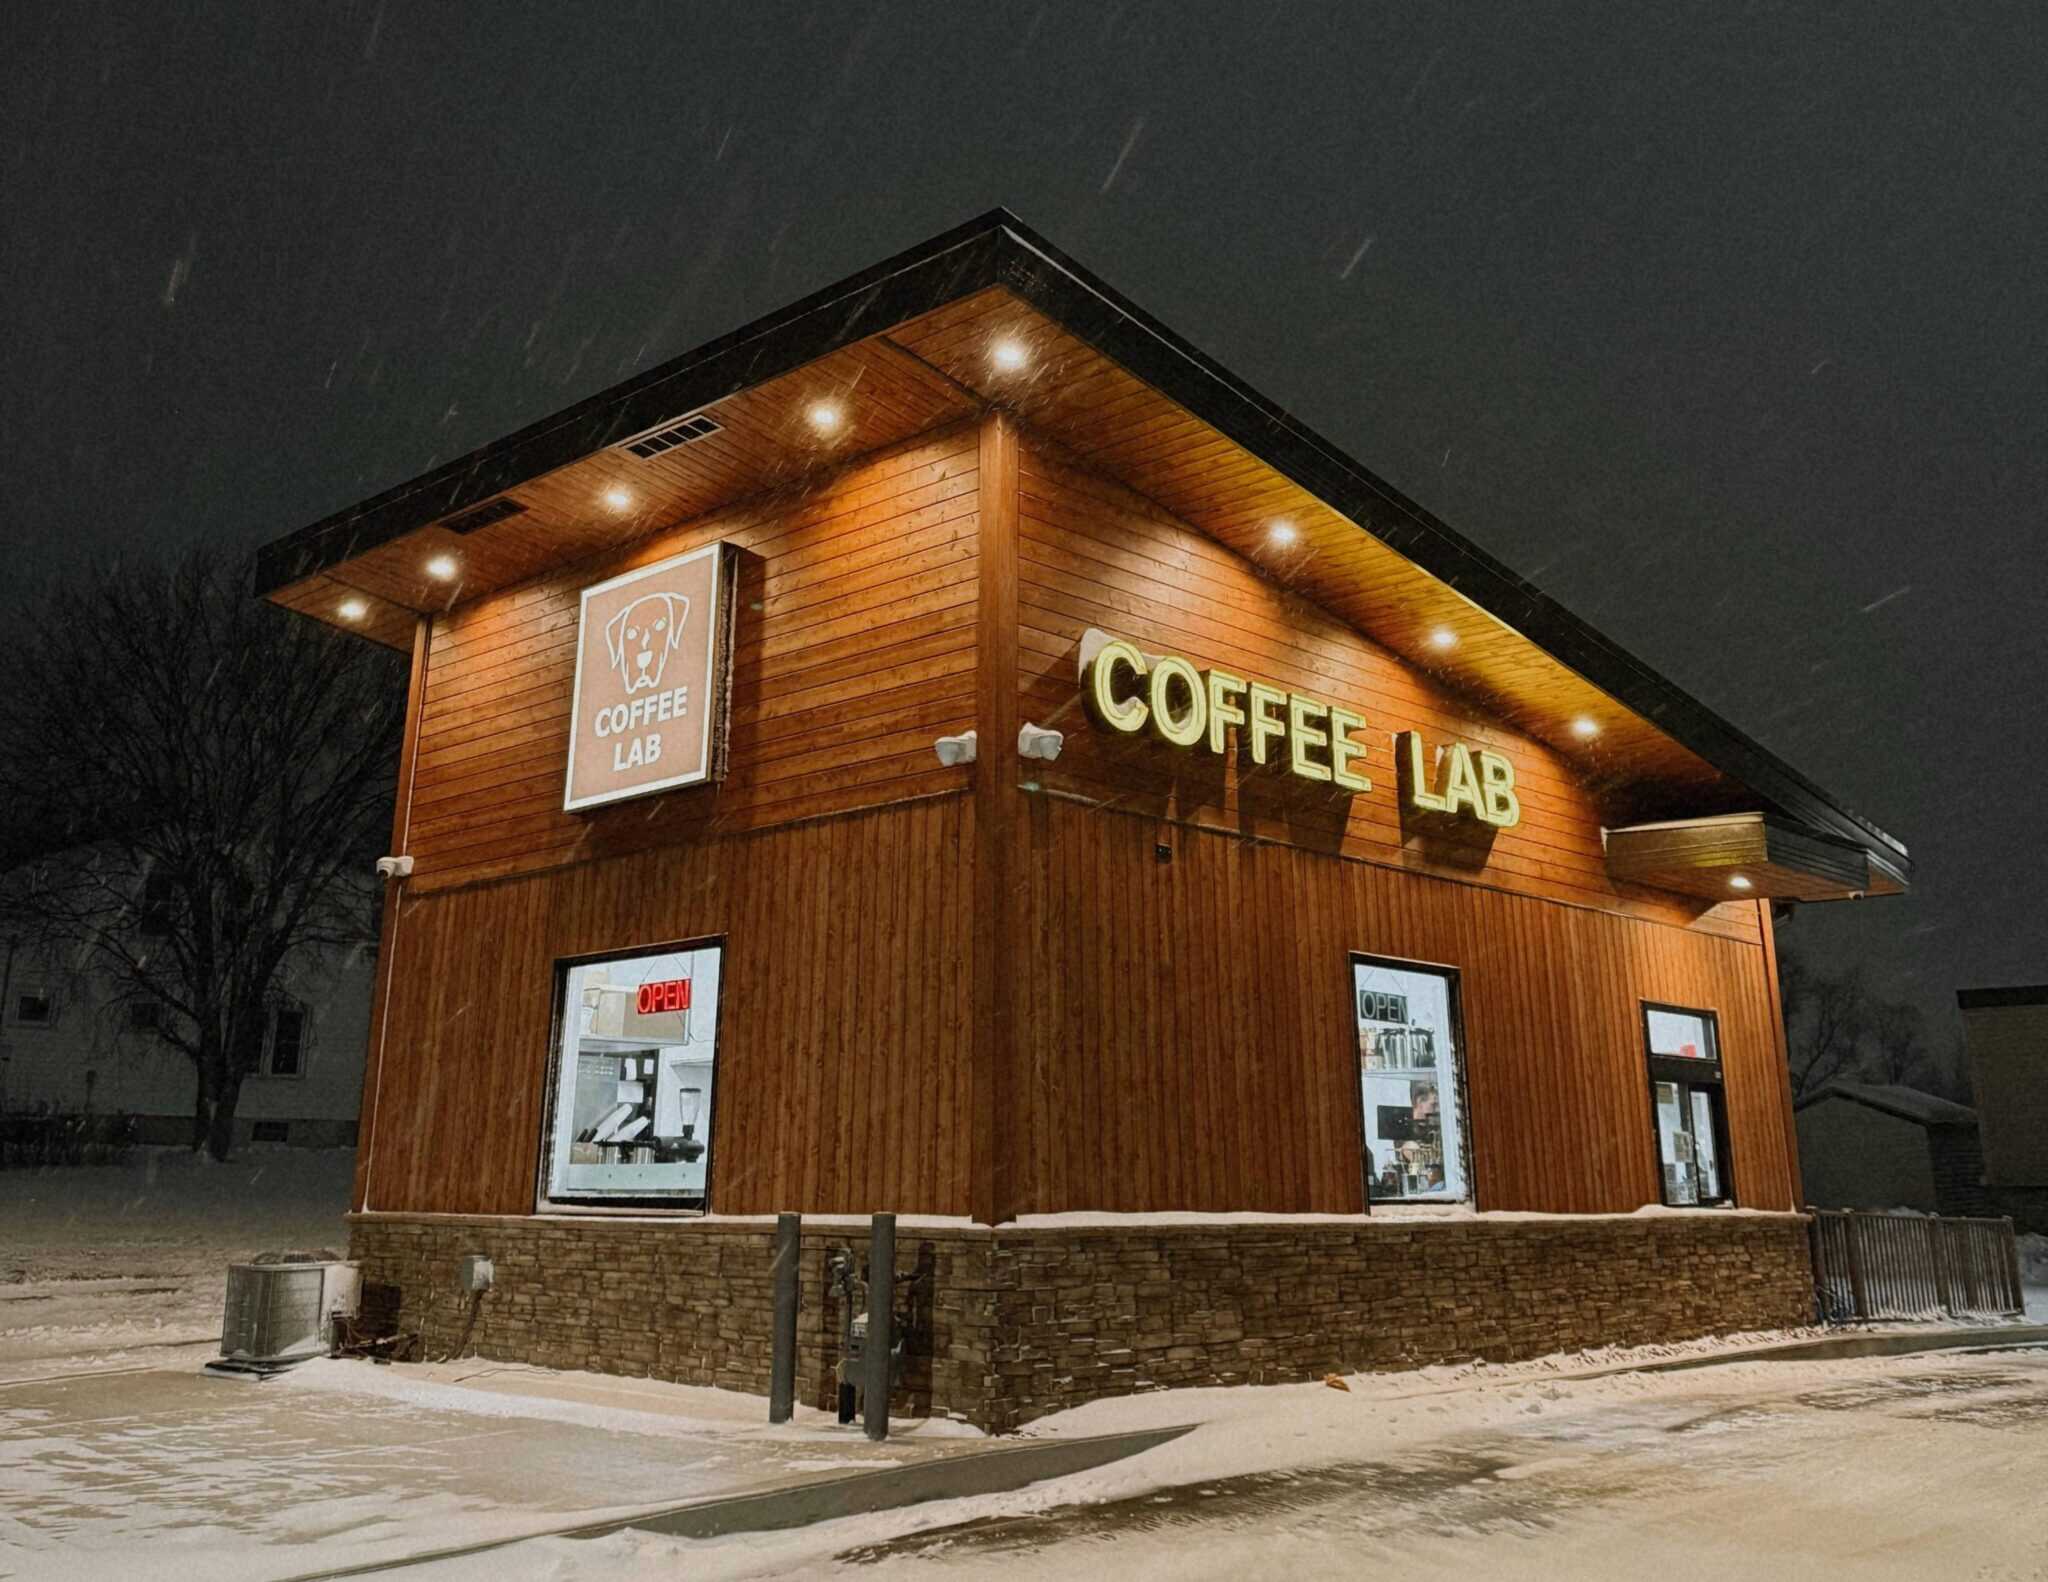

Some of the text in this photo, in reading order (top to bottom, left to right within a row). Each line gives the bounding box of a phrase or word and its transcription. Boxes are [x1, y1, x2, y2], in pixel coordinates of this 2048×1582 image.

[595, 687, 688, 737] COFFEE
[614, 734, 661, 771] LAB
[1095, 641, 1519, 827] COFFEE LAB
[639, 980, 689, 1013] OPEN
[1362, 991, 1408, 1024] OPEN
